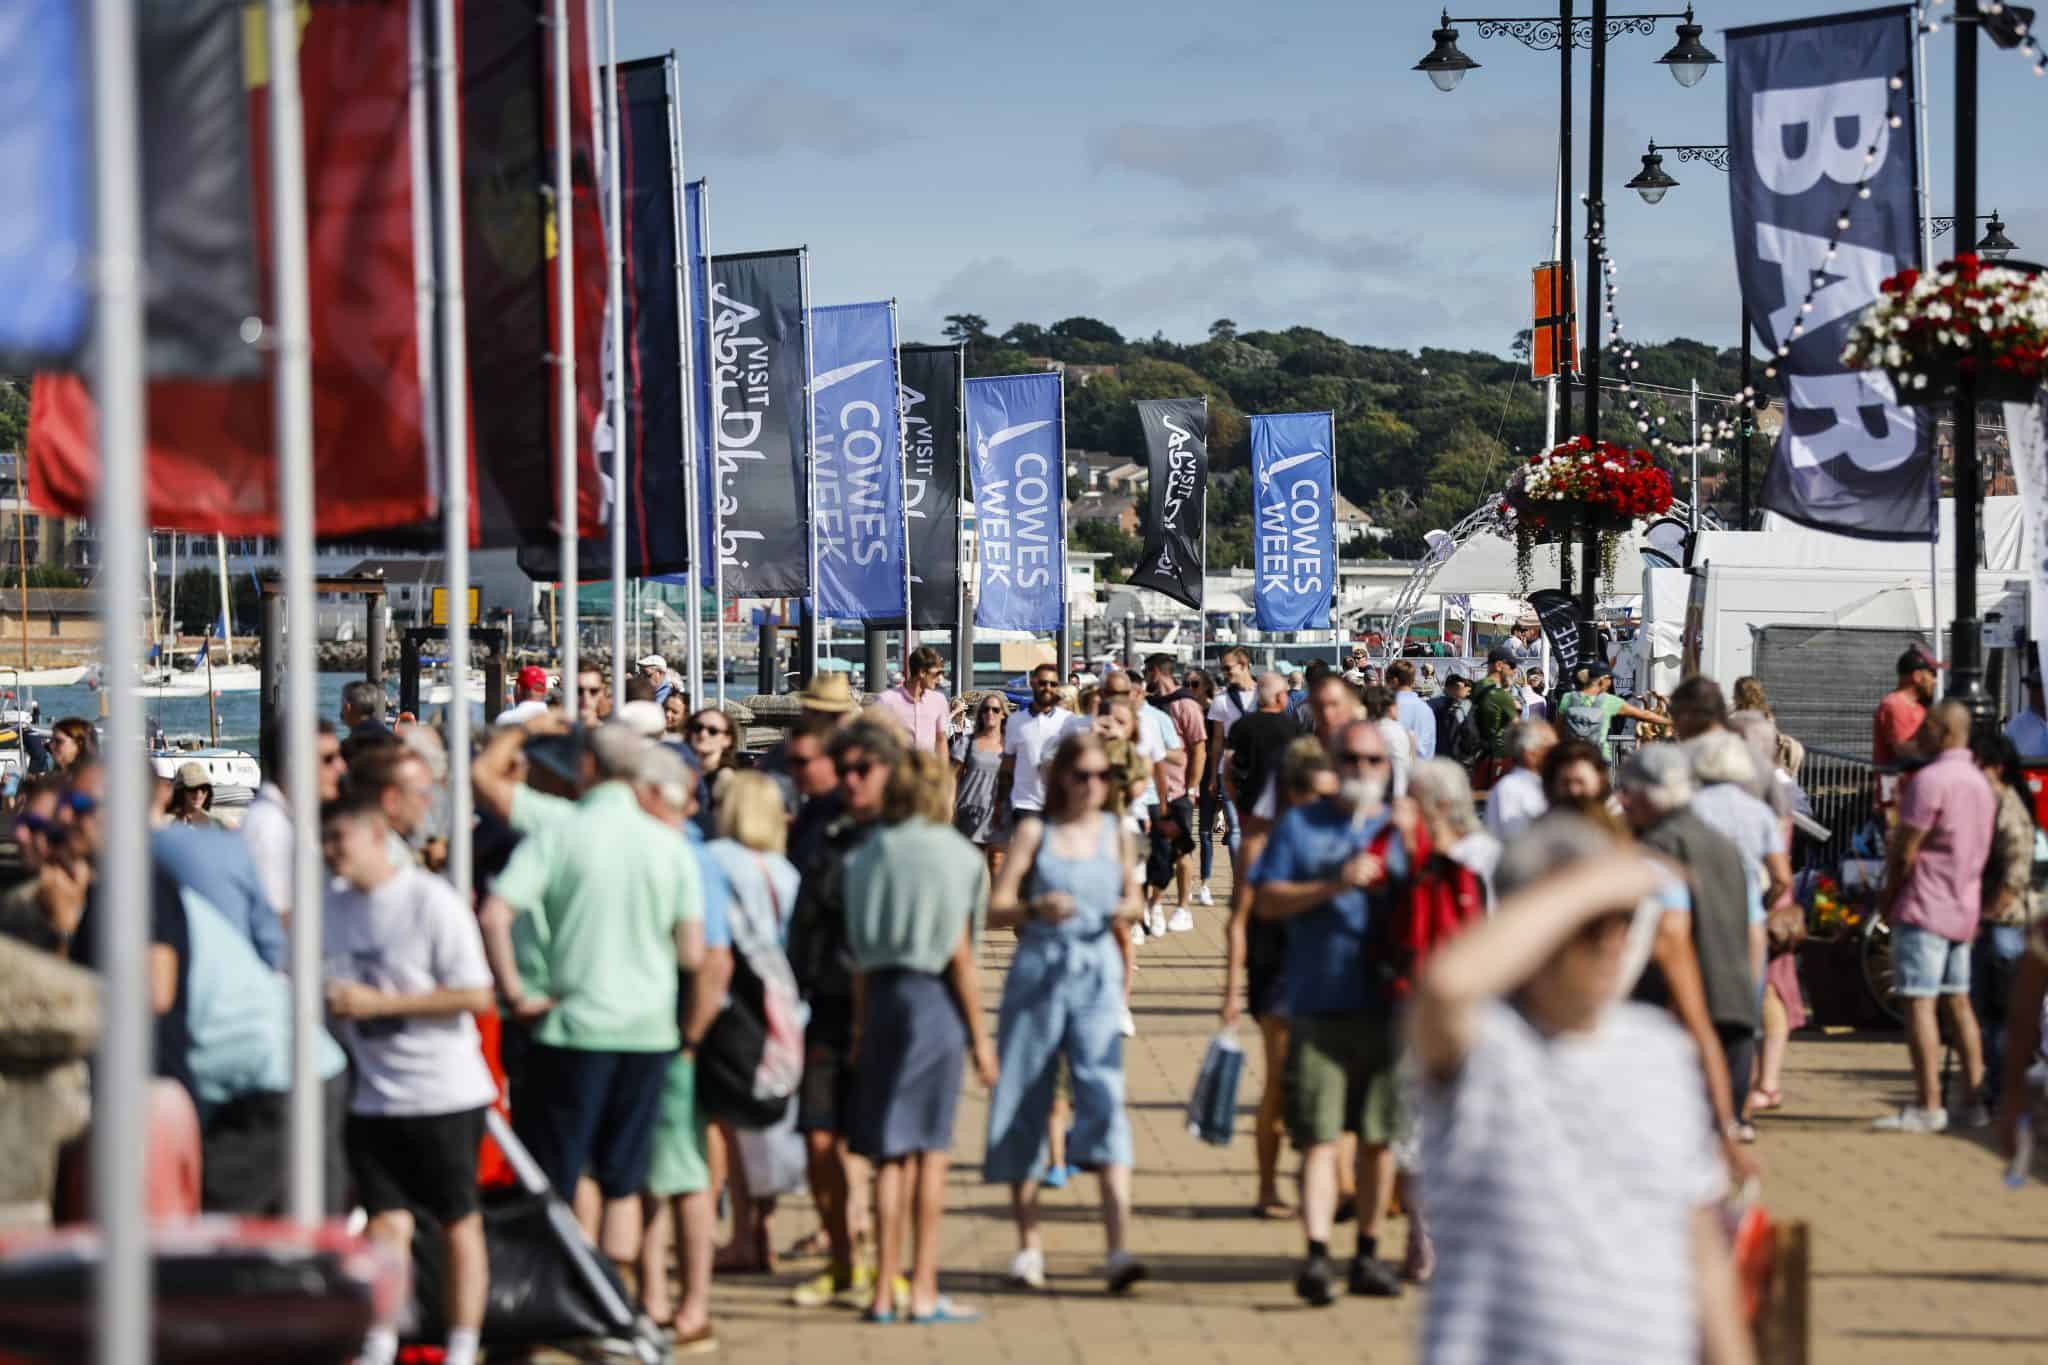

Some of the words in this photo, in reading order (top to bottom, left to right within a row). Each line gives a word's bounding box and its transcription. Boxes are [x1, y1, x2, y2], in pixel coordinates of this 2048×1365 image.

[1751, 76, 1918, 473] BAR
[748, 346, 770, 407] VISIT
[810, 433, 848, 565] WEEK
[840, 400, 888, 566] COWES
[915, 425, 933, 477] VISIT
[1177, 458, 1196, 499] VISIT
[981, 479, 1011, 589] WEEK
[1015, 452, 1049, 589] COWES
[1262, 502, 1289, 594] WEEK
[1291, 479, 1322, 594] COWES
